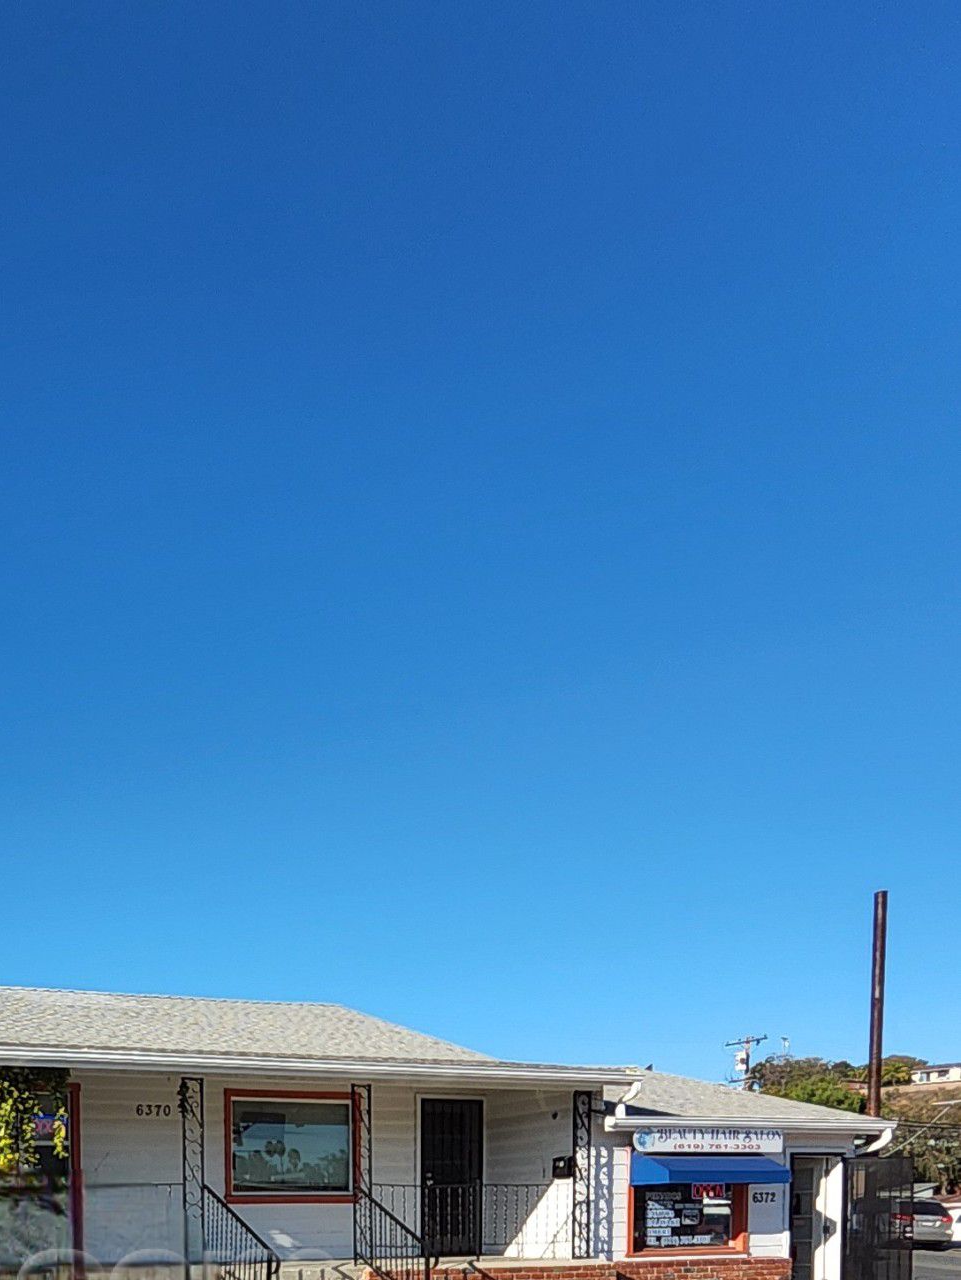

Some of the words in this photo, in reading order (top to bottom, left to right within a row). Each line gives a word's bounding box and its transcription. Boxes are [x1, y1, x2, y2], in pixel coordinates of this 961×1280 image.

[135, 1104, 171, 1117] 6370
[656, 1127, 706, 1143] BEAUTY
[710, 1128, 740, 1140] HAIR
[743, 1128, 782, 1143] SALON
[673, 1143, 704, 1151] (619)
[752, 1192, 776, 1204] 6372
